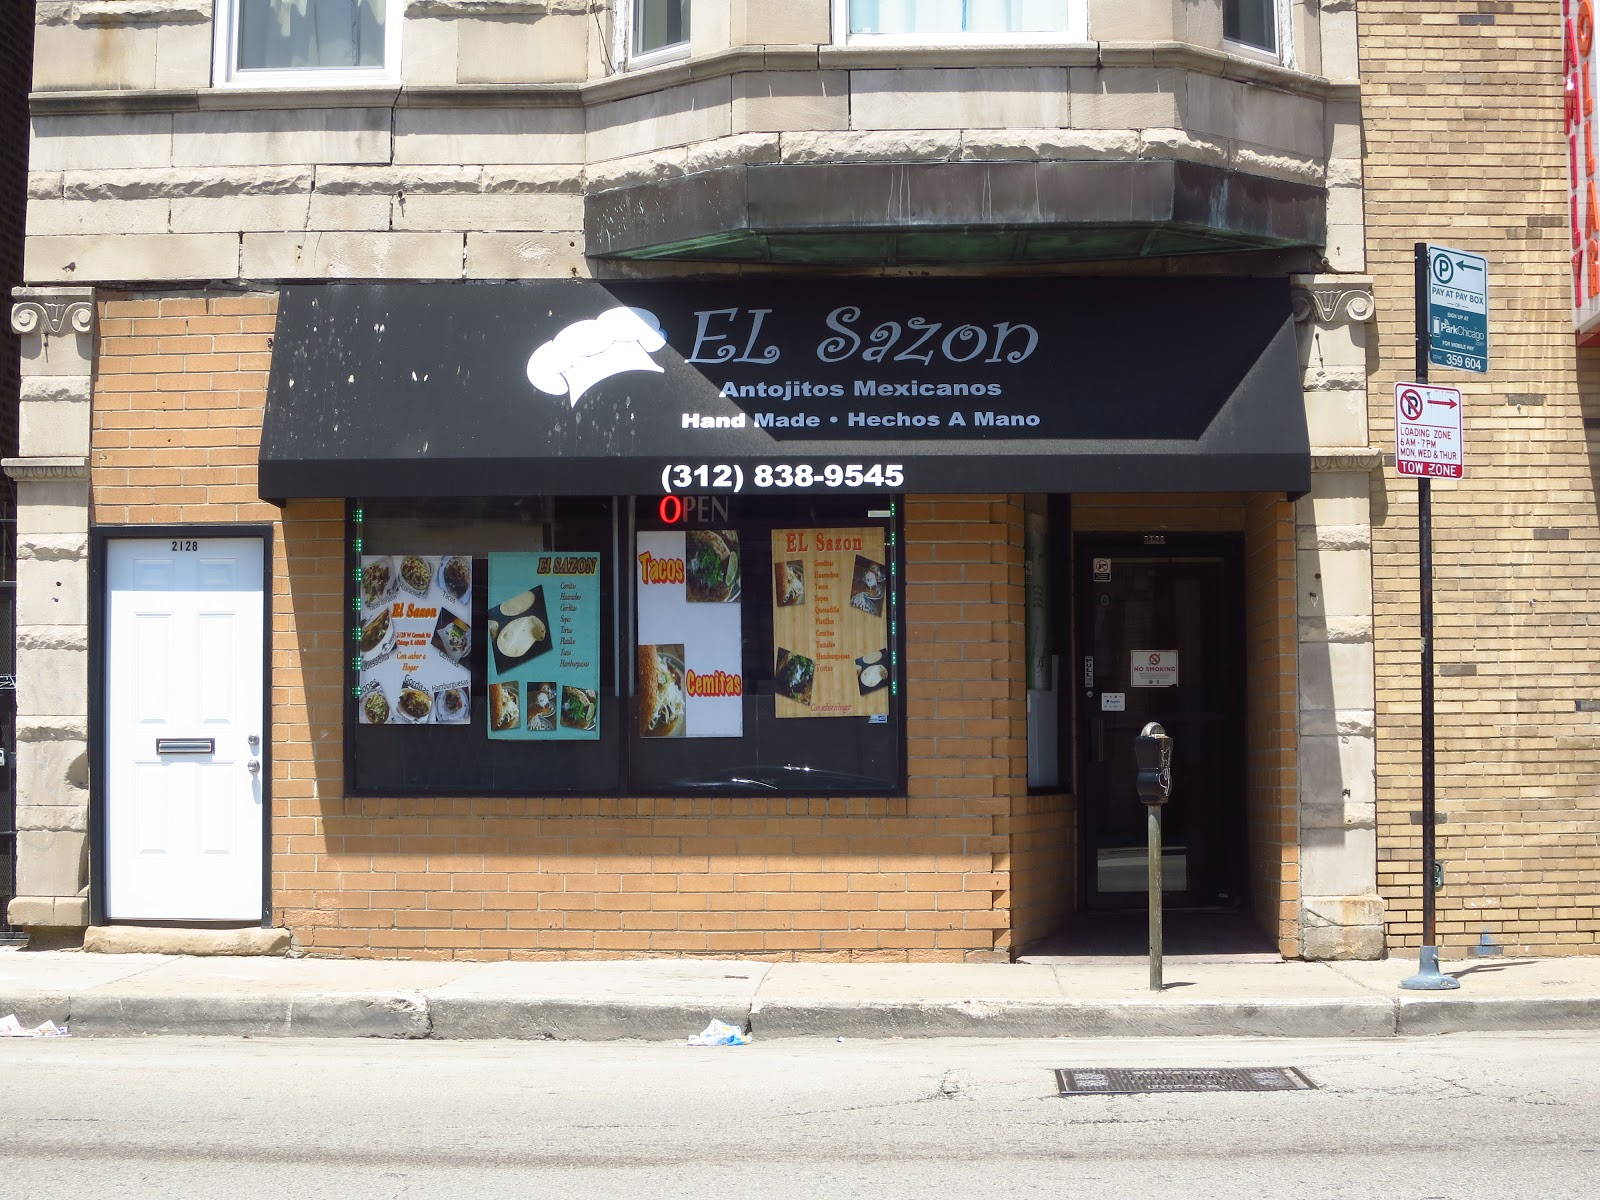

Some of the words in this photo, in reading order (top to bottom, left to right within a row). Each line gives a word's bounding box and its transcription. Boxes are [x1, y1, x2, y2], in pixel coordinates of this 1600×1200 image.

[1562, 0, 1583, 308] AMILY
[1577, 0, 1600, 300] OLLAR
[1432, 286, 1445, 297] PAY
[1445, 290, 1454, 299] AT
[1455, 293, 1468, 302] PAY
[1469, 295, 1484, 305] BOX
[684, 307, 781, 365] EL
[816, 305, 1039, 366] Sazon
[1451, 342, 1466, 350] MOBILE
[1446, 353, 1463, 366] 359
[1464, 357, 1481, 370] 604
[719, 380, 845, 400] Antojitos
[854, 379, 1002, 398] Mexicanos
[681, 413, 746, 429] Hand
[754, 411, 821, 428] Made
[848, 411, 940, 428] Hechos
[948, 411, 966, 427] A
[974, 410, 1041, 427] Mano
[1400, 427, 1431, 438] LOADING
[1433, 430, 1452, 440] ZONE
[1418, 449, 1432, 459] WED
[1433, 451, 1438, 459] &
[1439, 451, 1457, 460] THUR
[1401, 461, 1424, 474] TOW
[1428, 463, 1457, 476] ZONE
[661, 464, 744, 493] (312)
[754, 464, 904, 488] 838-9545
[659, 495, 729, 524] OPEN
[172, 541, 198, 551] 2128
[786, 533, 808, 553] EL
[816, 531, 863, 552] Sazon
[553, 556, 598, 575] SAZON
[639, 551, 684, 584] Tacos
[406, 603, 437, 618] Sazon
[686, 669, 743, 697] Cemitas
